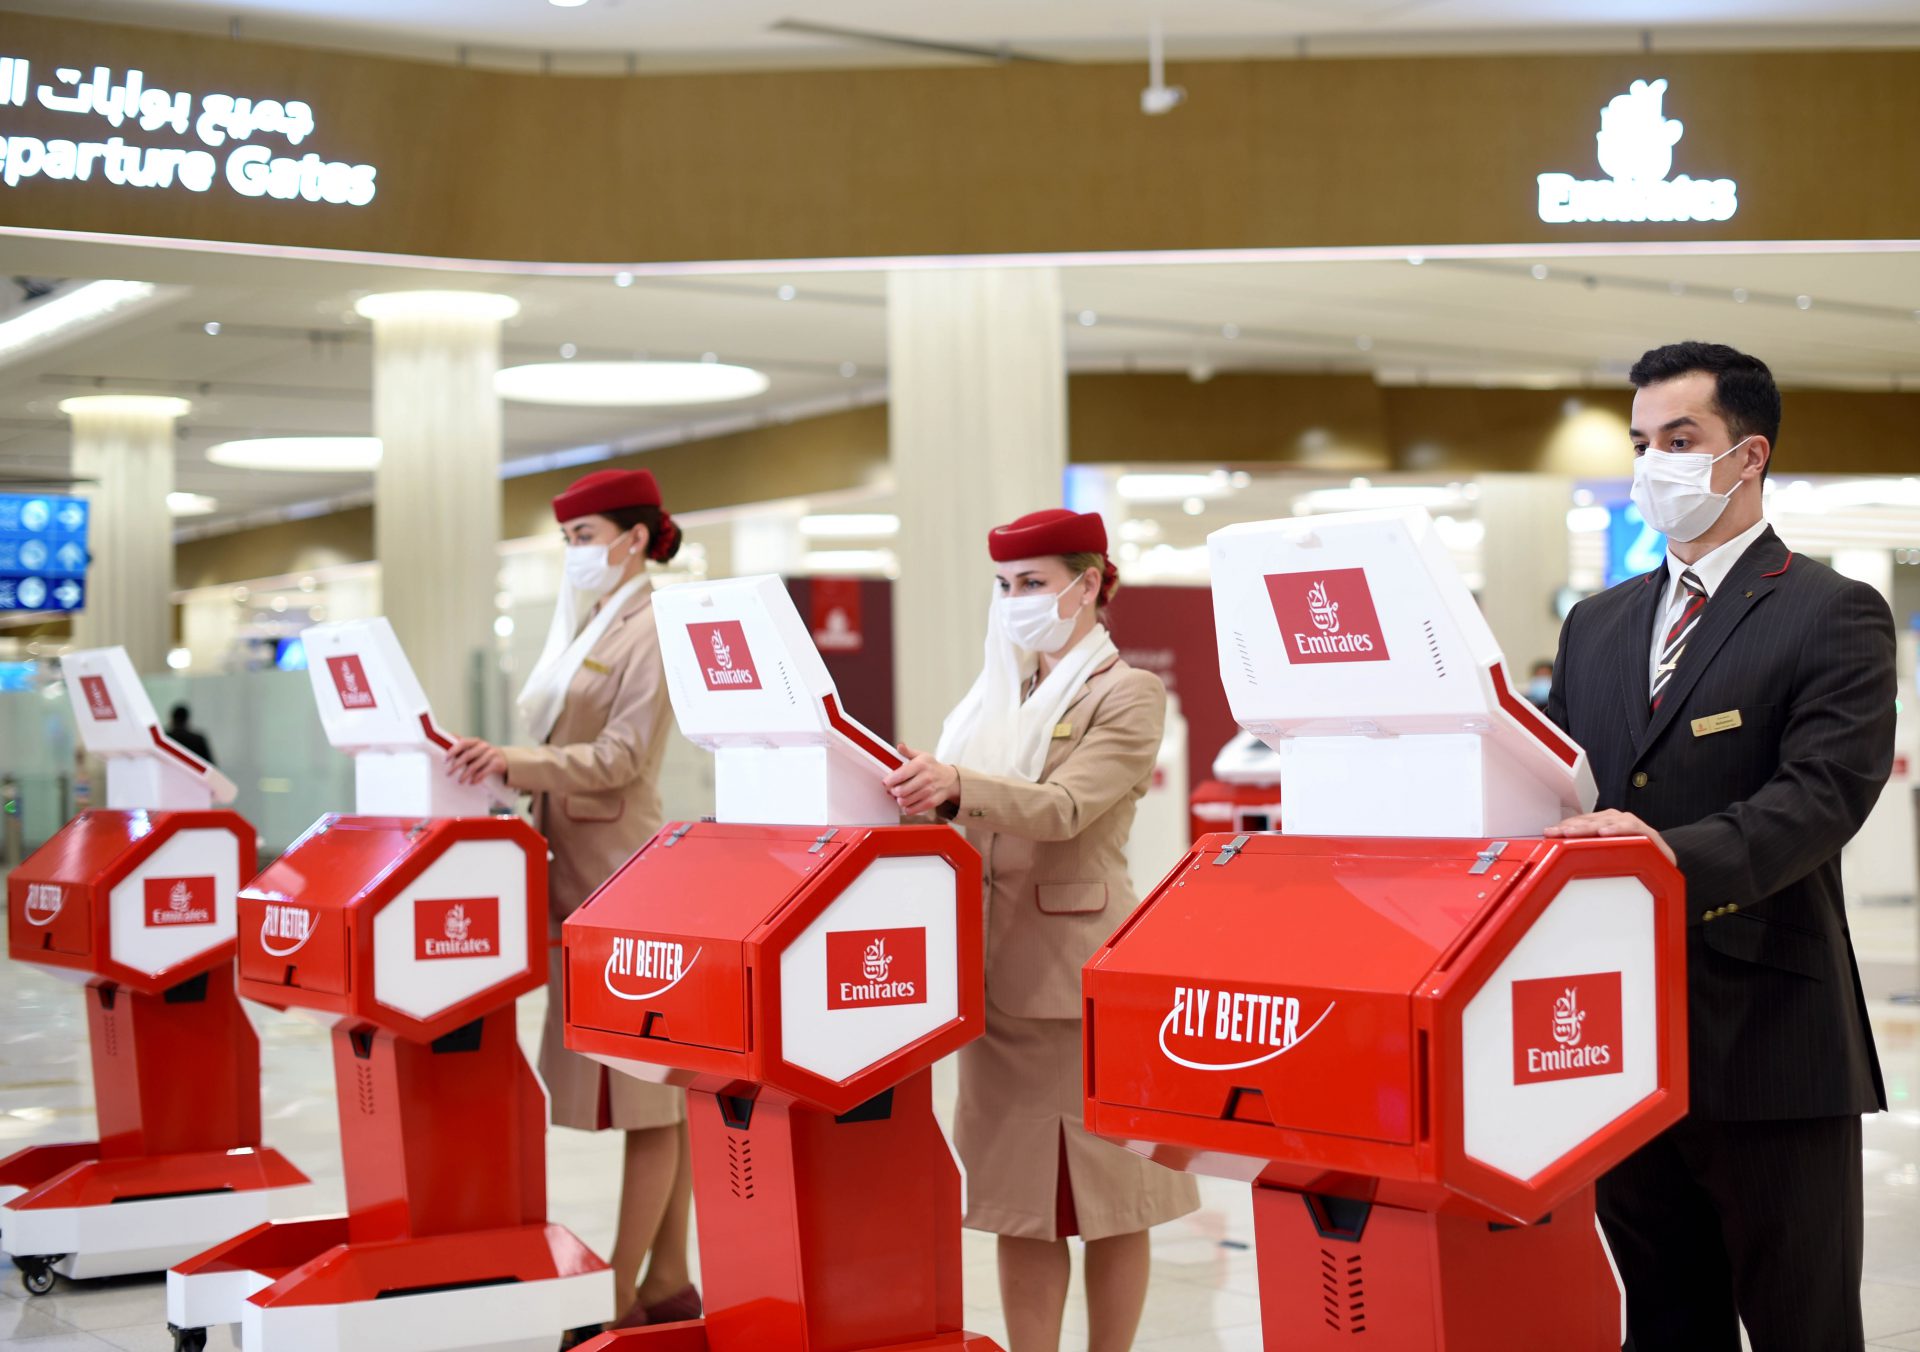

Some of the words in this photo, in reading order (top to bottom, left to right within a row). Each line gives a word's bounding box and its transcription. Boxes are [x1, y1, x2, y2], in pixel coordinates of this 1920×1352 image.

[0, 135, 216, 192] parture
[225, 144, 377, 206] Gates
[1294, 630, 1374, 655] Emirates
[707, 667, 753, 685] Emirates
[280, 905, 310, 940] BETTER
[425, 937, 491, 955] Emirates
[612, 936, 635, 976] FLY
[636, 938, 684, 982] BETTER
[840, 980, 915, 1002] Emirates
[1172, 986, 1210, 1038] FLY
[1214, 990, 1300, 1048] BETTER
[1527, 1044, 1611, 1073] Emirates
